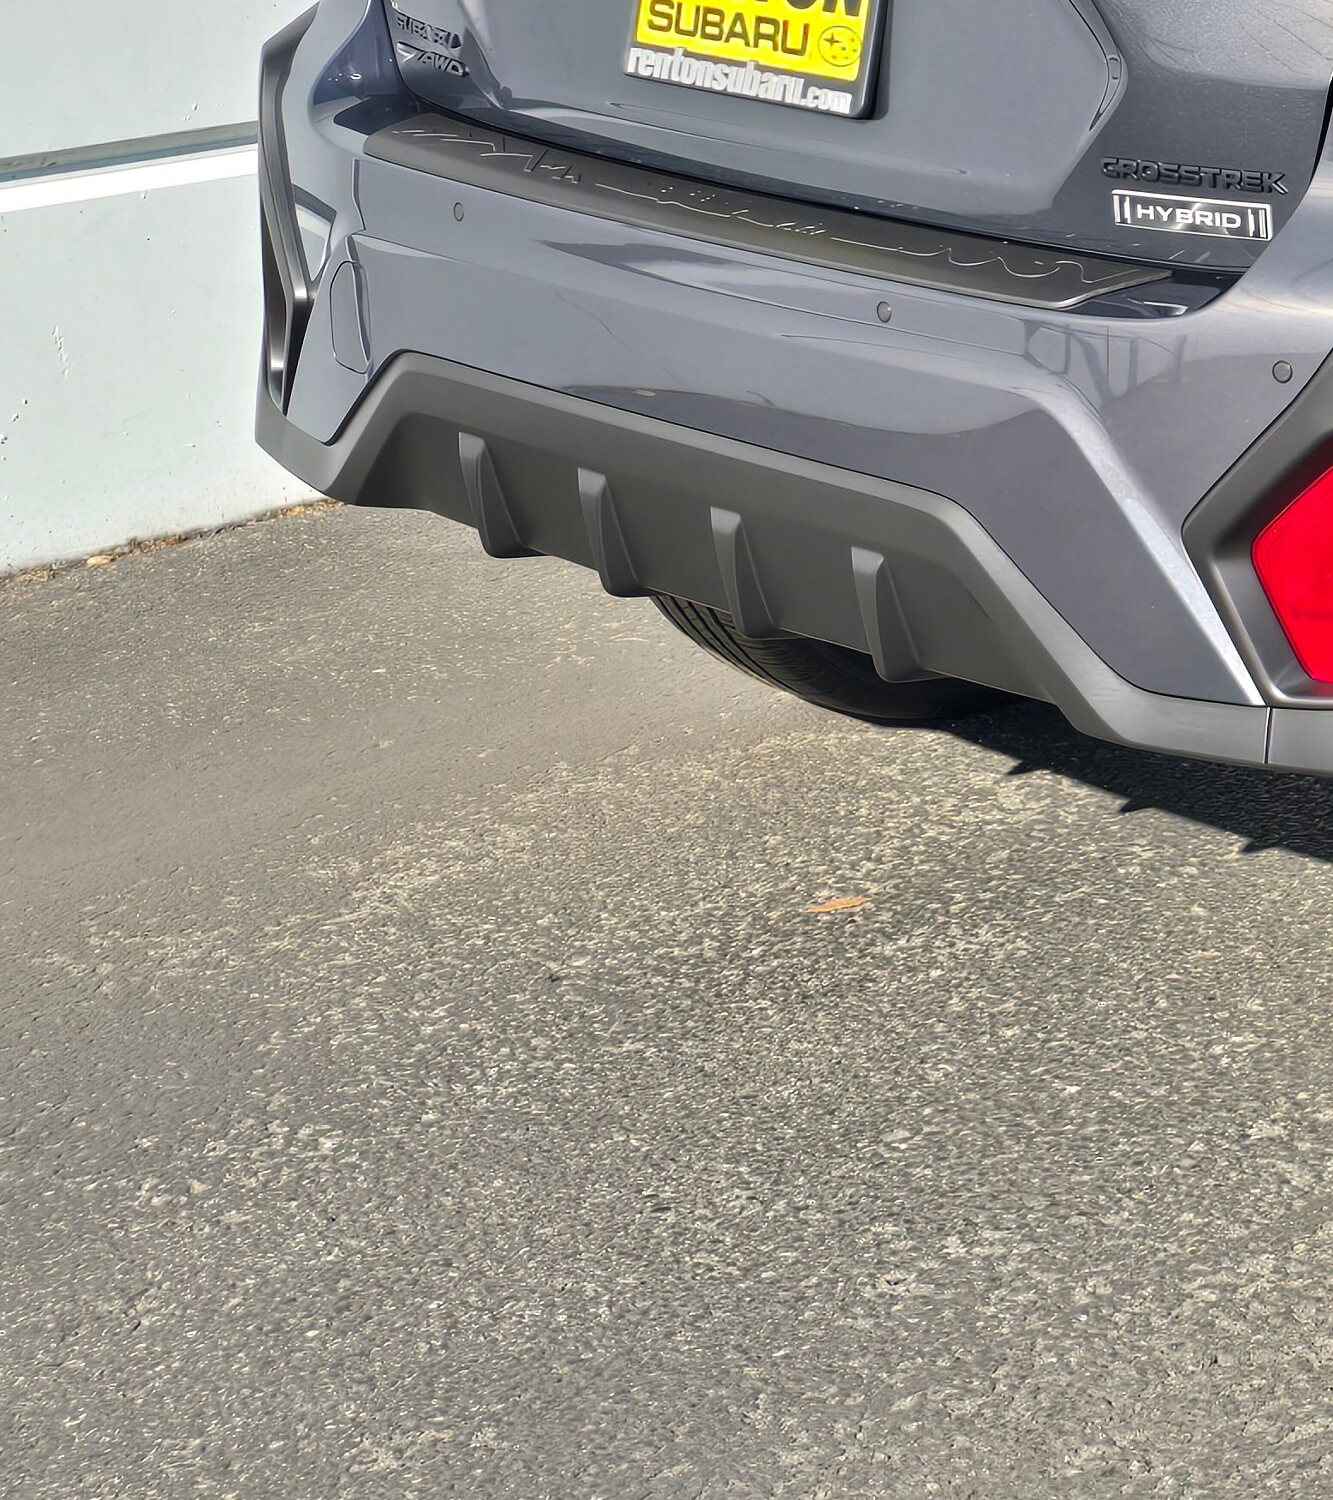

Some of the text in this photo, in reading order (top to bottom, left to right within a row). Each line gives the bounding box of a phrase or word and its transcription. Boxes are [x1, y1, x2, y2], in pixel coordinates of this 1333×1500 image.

[627, 47, 852, 115] rentonsubaru.com
[1101, 156, 1289, 195] CROSSTREK
[1136, 203, 1242, 229] HYBRID
